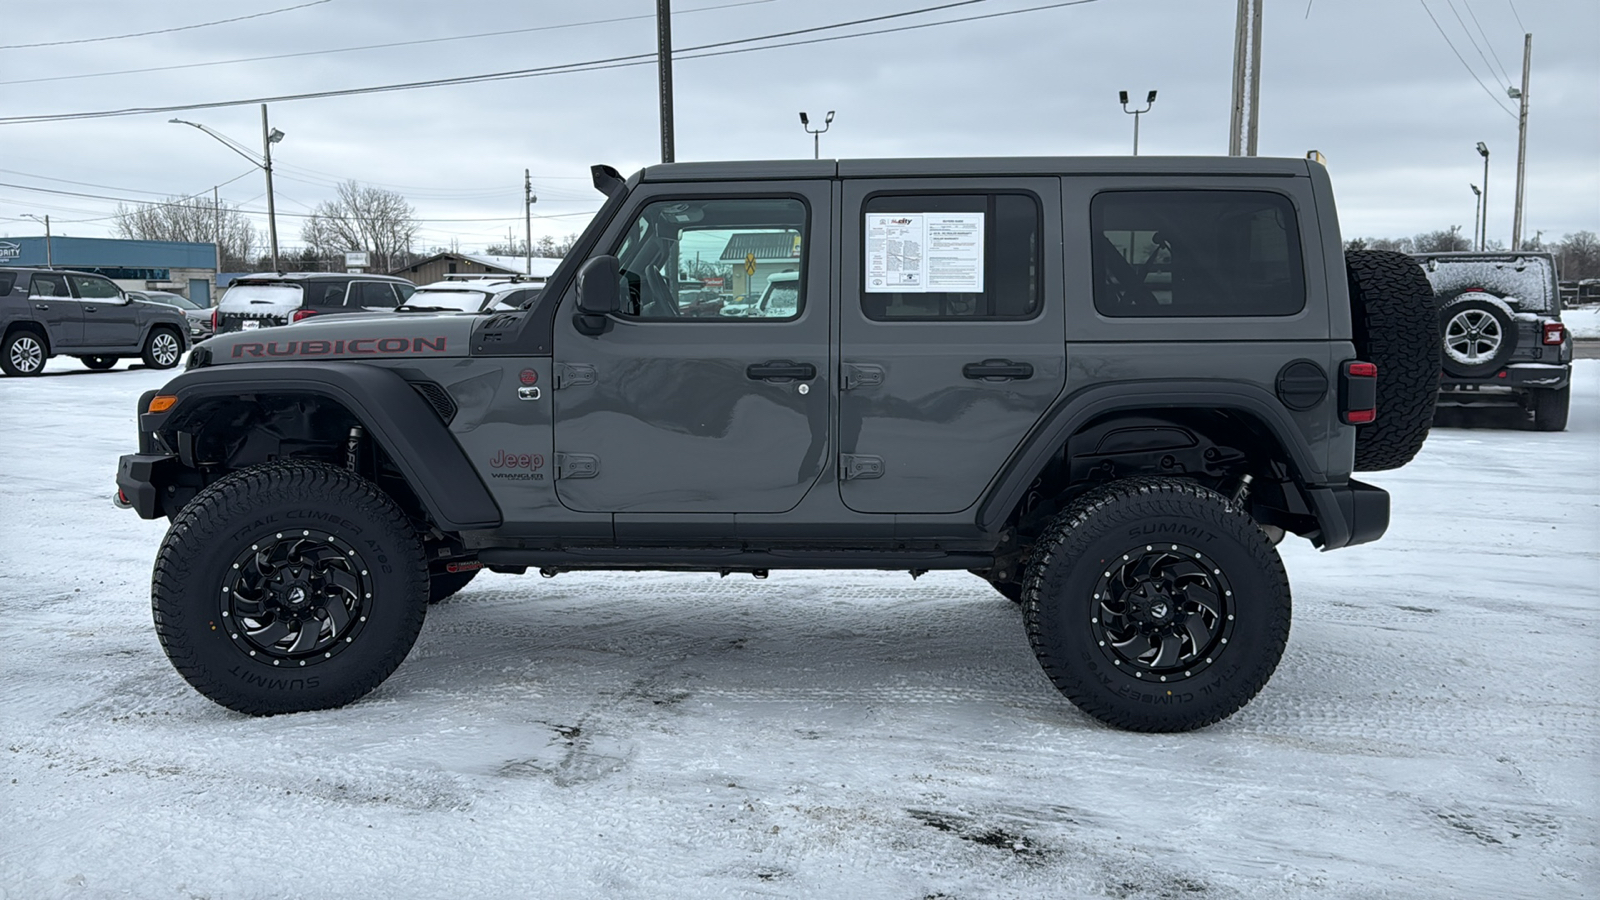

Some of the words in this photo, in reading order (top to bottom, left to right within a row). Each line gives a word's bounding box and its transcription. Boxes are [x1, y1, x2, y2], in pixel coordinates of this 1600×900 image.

[231, 337, 448, 358] RUBICON
[489, 449, 545, 472] Jeep
[231, 515, 279, 541] TRAIL
[286, 510, 363, 535] CLIMBER
[1128, 523, 1218, 543] SUMMIT
[227, 665, 320, 690] SUMMIT
[1199, 664, 1241, 696] TRAIL
[1118, 684, 1195, 705] CLIMBER
